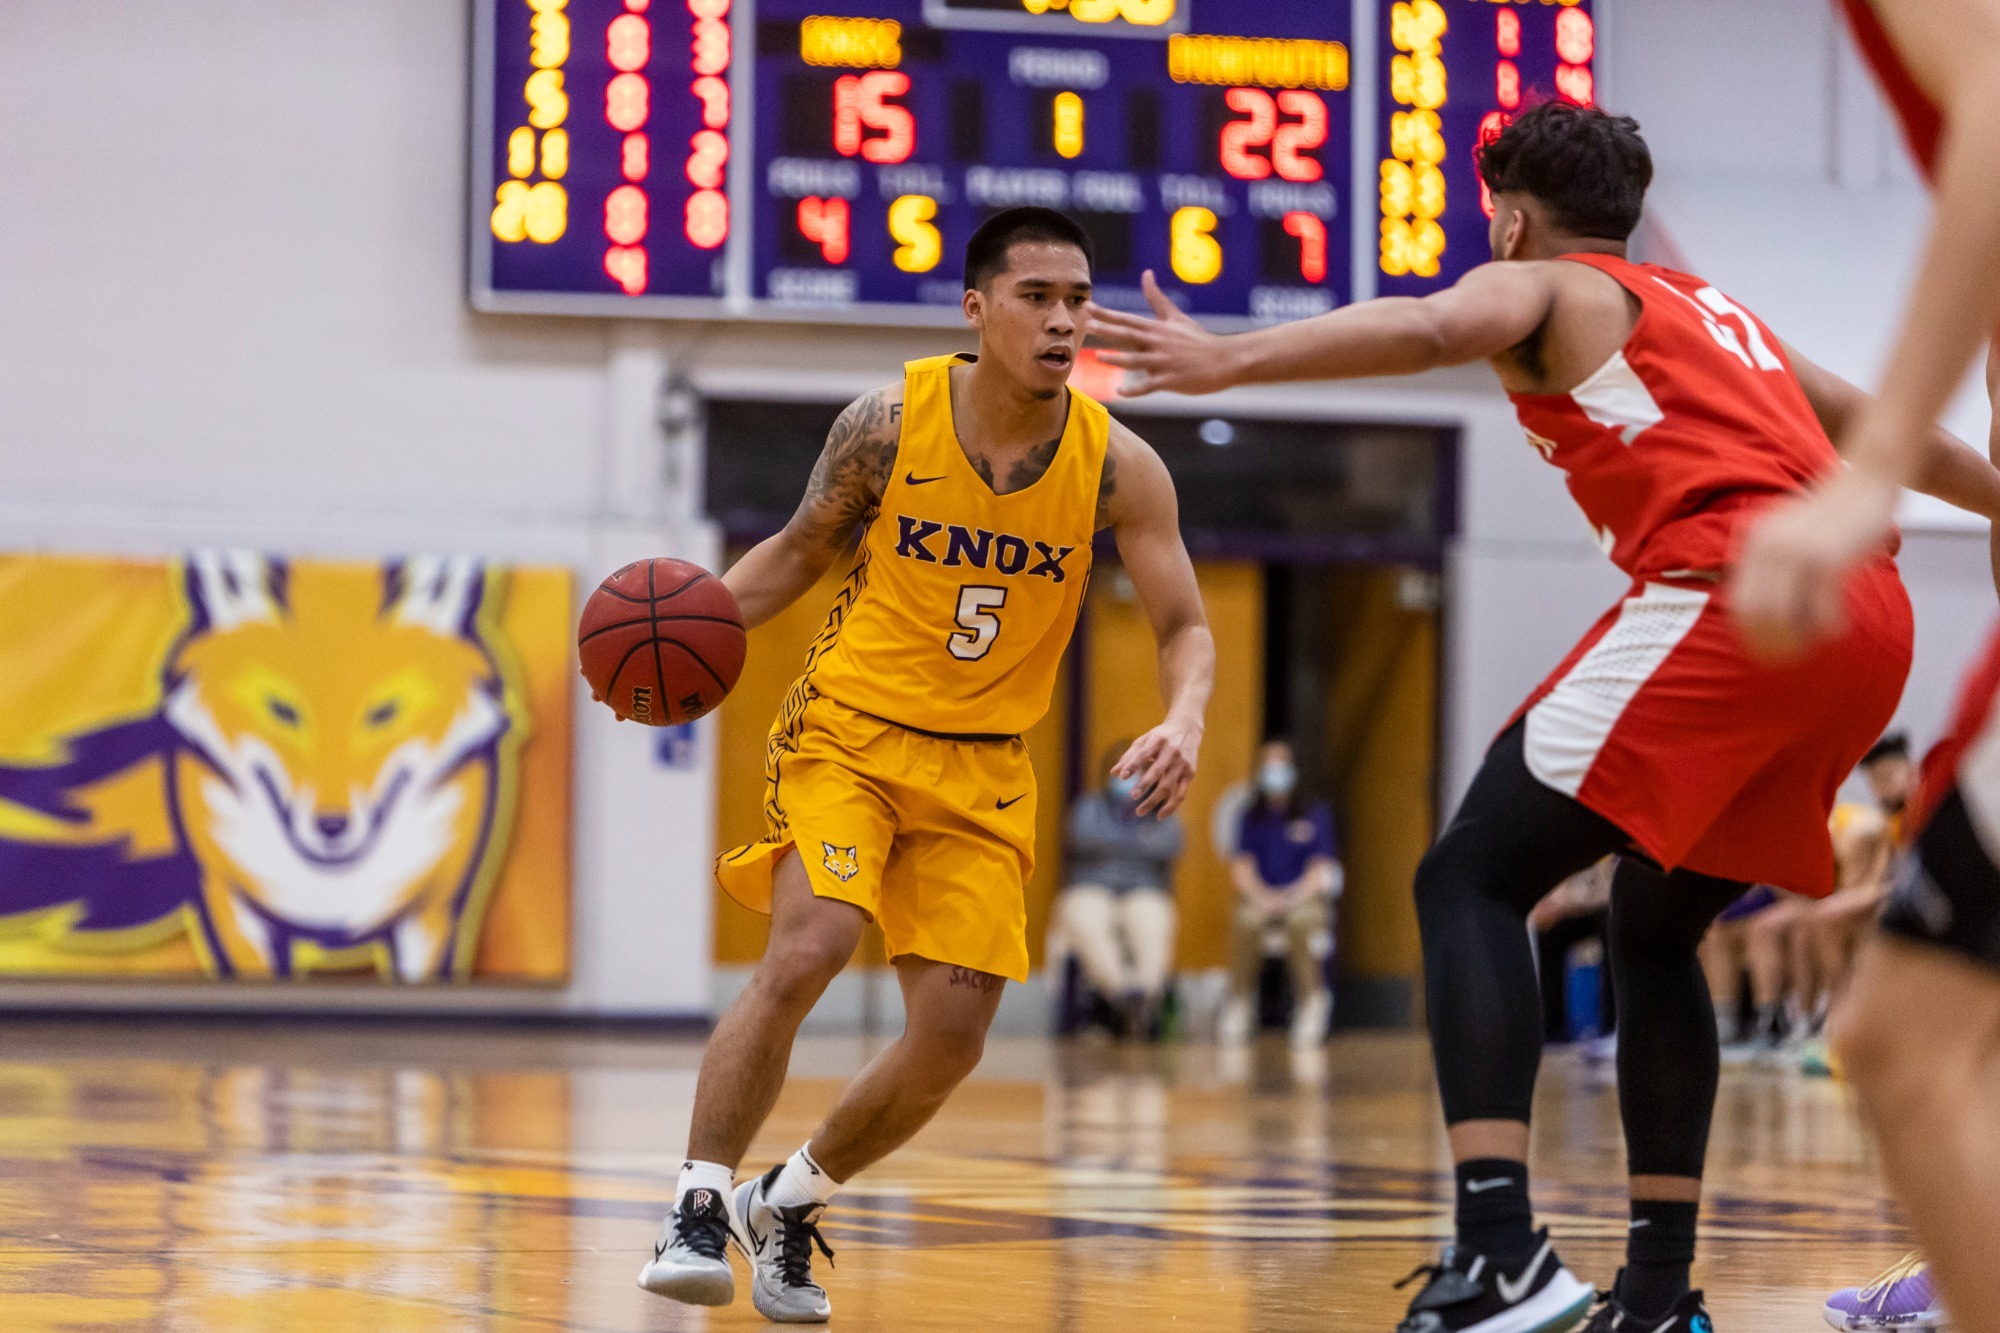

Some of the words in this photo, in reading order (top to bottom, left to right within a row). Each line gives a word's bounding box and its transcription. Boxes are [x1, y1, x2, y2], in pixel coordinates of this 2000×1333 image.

[524, 68, 569, 129] 5
[833, 70, 916, 163] 15
[1053, 91, 1083, 159] 1
[1220, 86, 1328, 182] 22
[507, 126, 569, 180] 11
[797, 195, 851, 265] 4
[888, 194, 943, 273] 5
[1170, 206, 1222, 284] 6
[1283, 211, 1328, 284] 7
[895, 514, 1077, 583] KNOX
[946, 584, 1009, 662] 5
